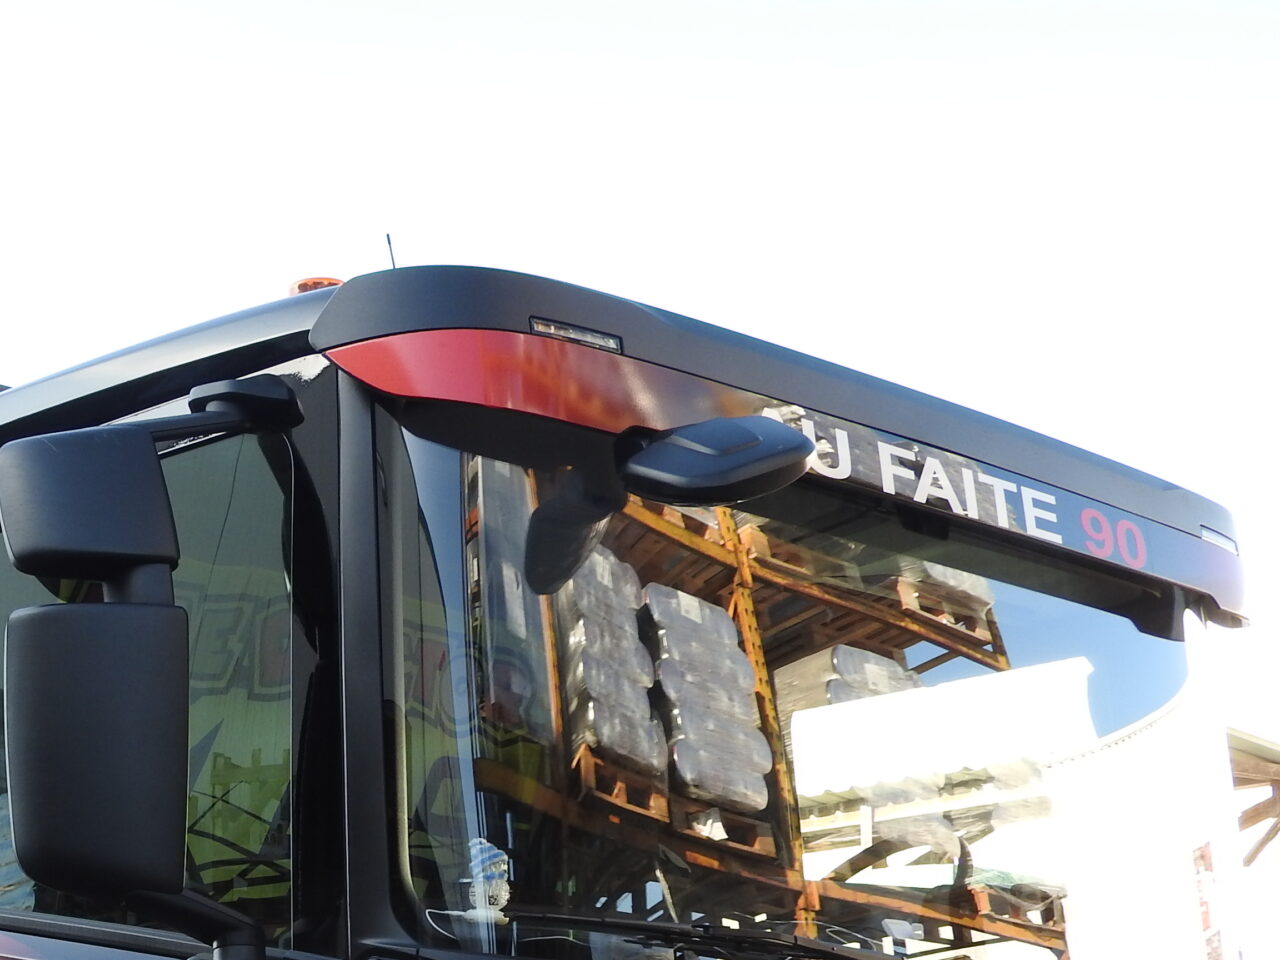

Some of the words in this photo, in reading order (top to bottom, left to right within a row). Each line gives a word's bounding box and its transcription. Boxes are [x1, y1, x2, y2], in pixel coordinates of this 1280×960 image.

[762, 407, 851, 480] U
[877, 441, 1063, 544] FAITE
[1080, 508, 1147, 569] 90
